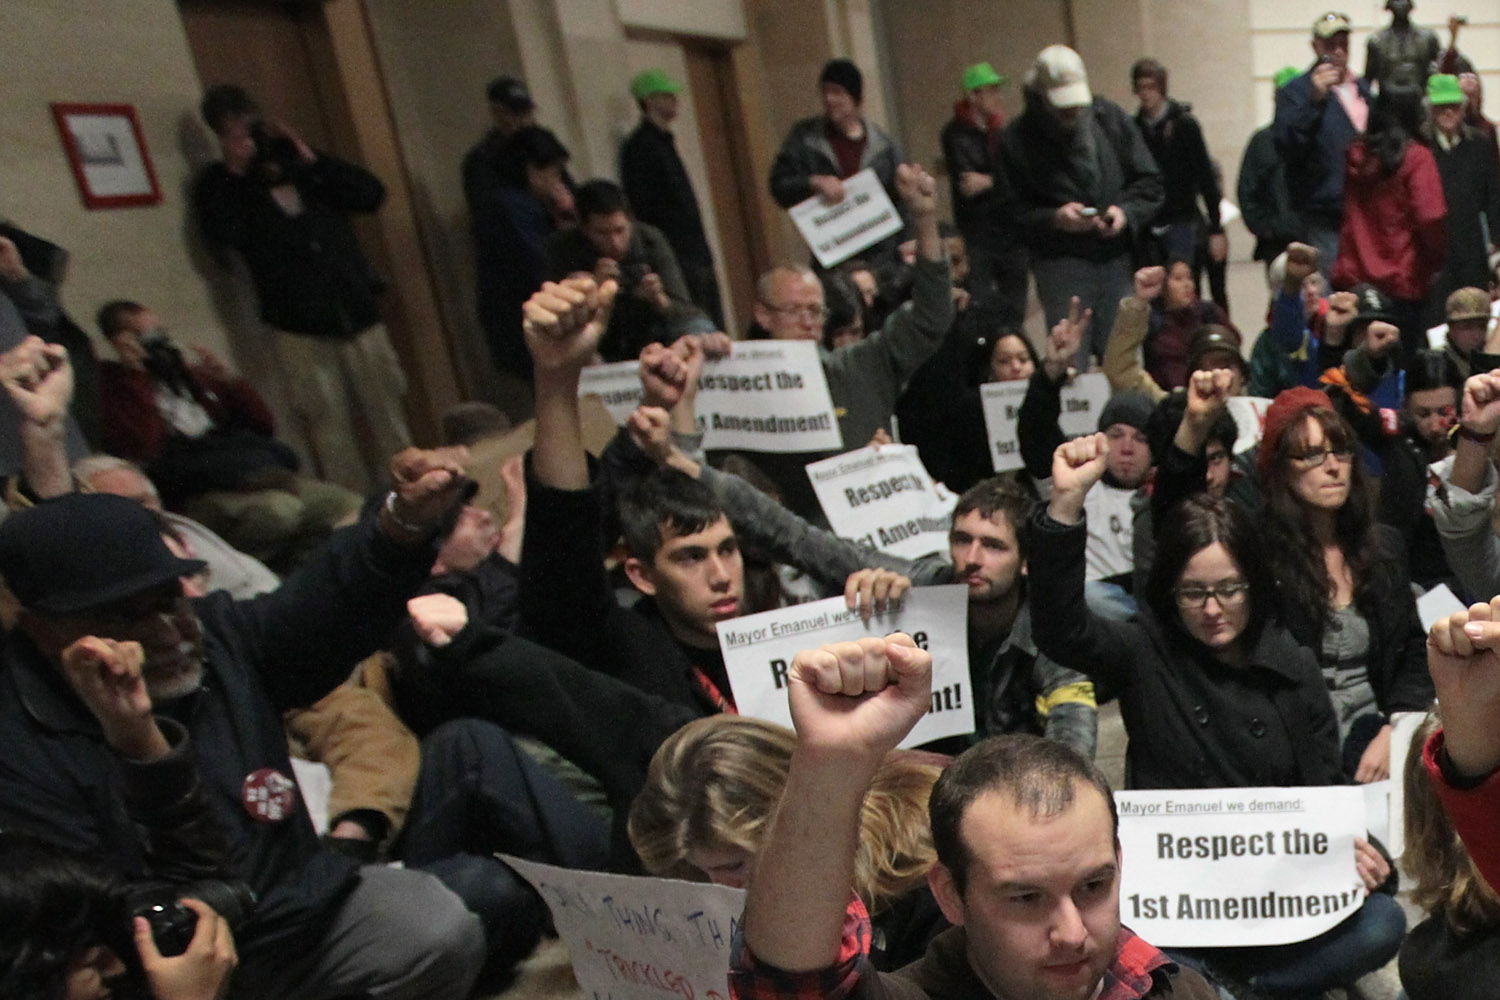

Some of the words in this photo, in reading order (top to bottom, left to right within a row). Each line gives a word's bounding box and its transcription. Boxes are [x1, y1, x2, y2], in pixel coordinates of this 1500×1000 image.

[725, 629, 767, 648] Mayor
[770, 613, 830, 638] Emanuel
[1120, 801, 1162, 817] Mayor
[1165, 800, 1223, 814] Emanuel
[1226, 802, 1245, 811] we
[1248, 799, 1305, 812] demand:
[1156, 832, 1276, 861] Respect
[1283, 829, 1328, 856] the
[1128, 893, 1170, 919] 1st
